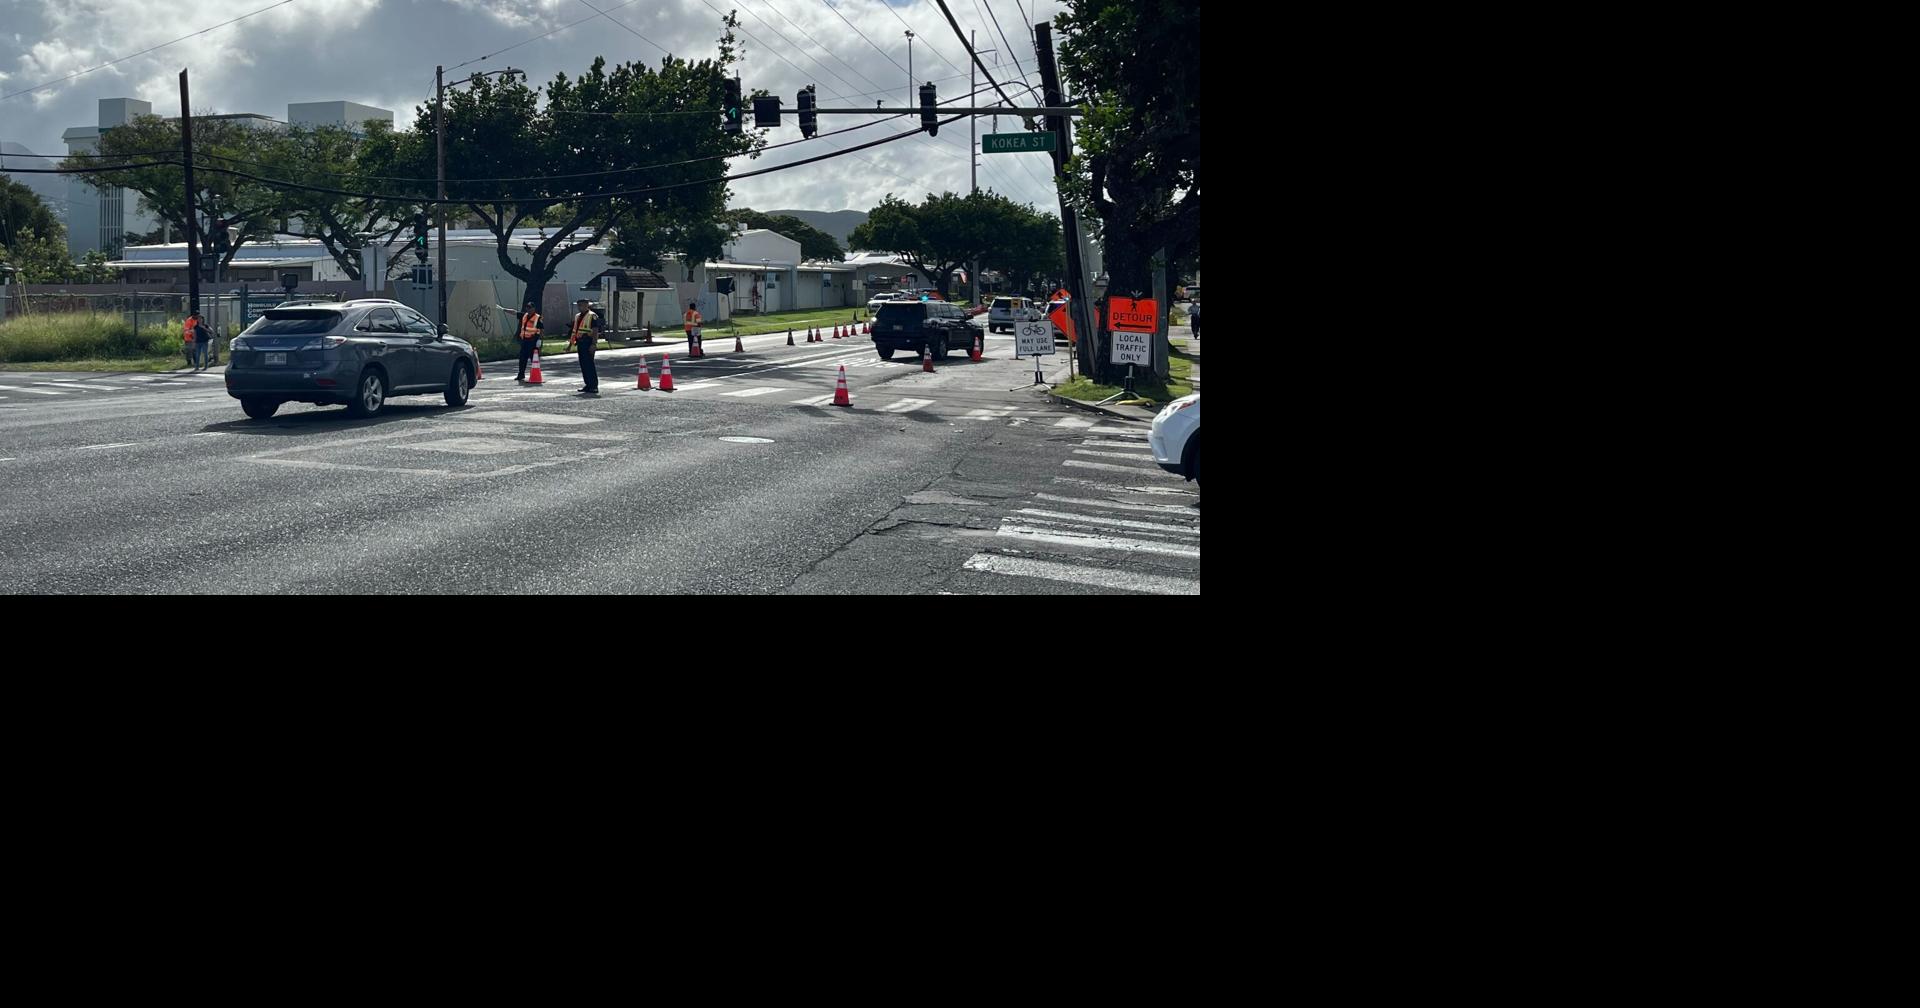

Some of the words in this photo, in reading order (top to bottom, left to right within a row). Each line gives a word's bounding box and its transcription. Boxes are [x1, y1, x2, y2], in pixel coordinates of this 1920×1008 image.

[991, 137, 1027, 149] KOKEA
[1032, 136, 1046, 147] ST
[1112, 312, 1153, 322] DETOUR
[1119, 334, 1144, 343] LOCAL
[1116, 343, 1147, 353] TRAFFIC
[1120, 353, 1141, 362] ONLY
